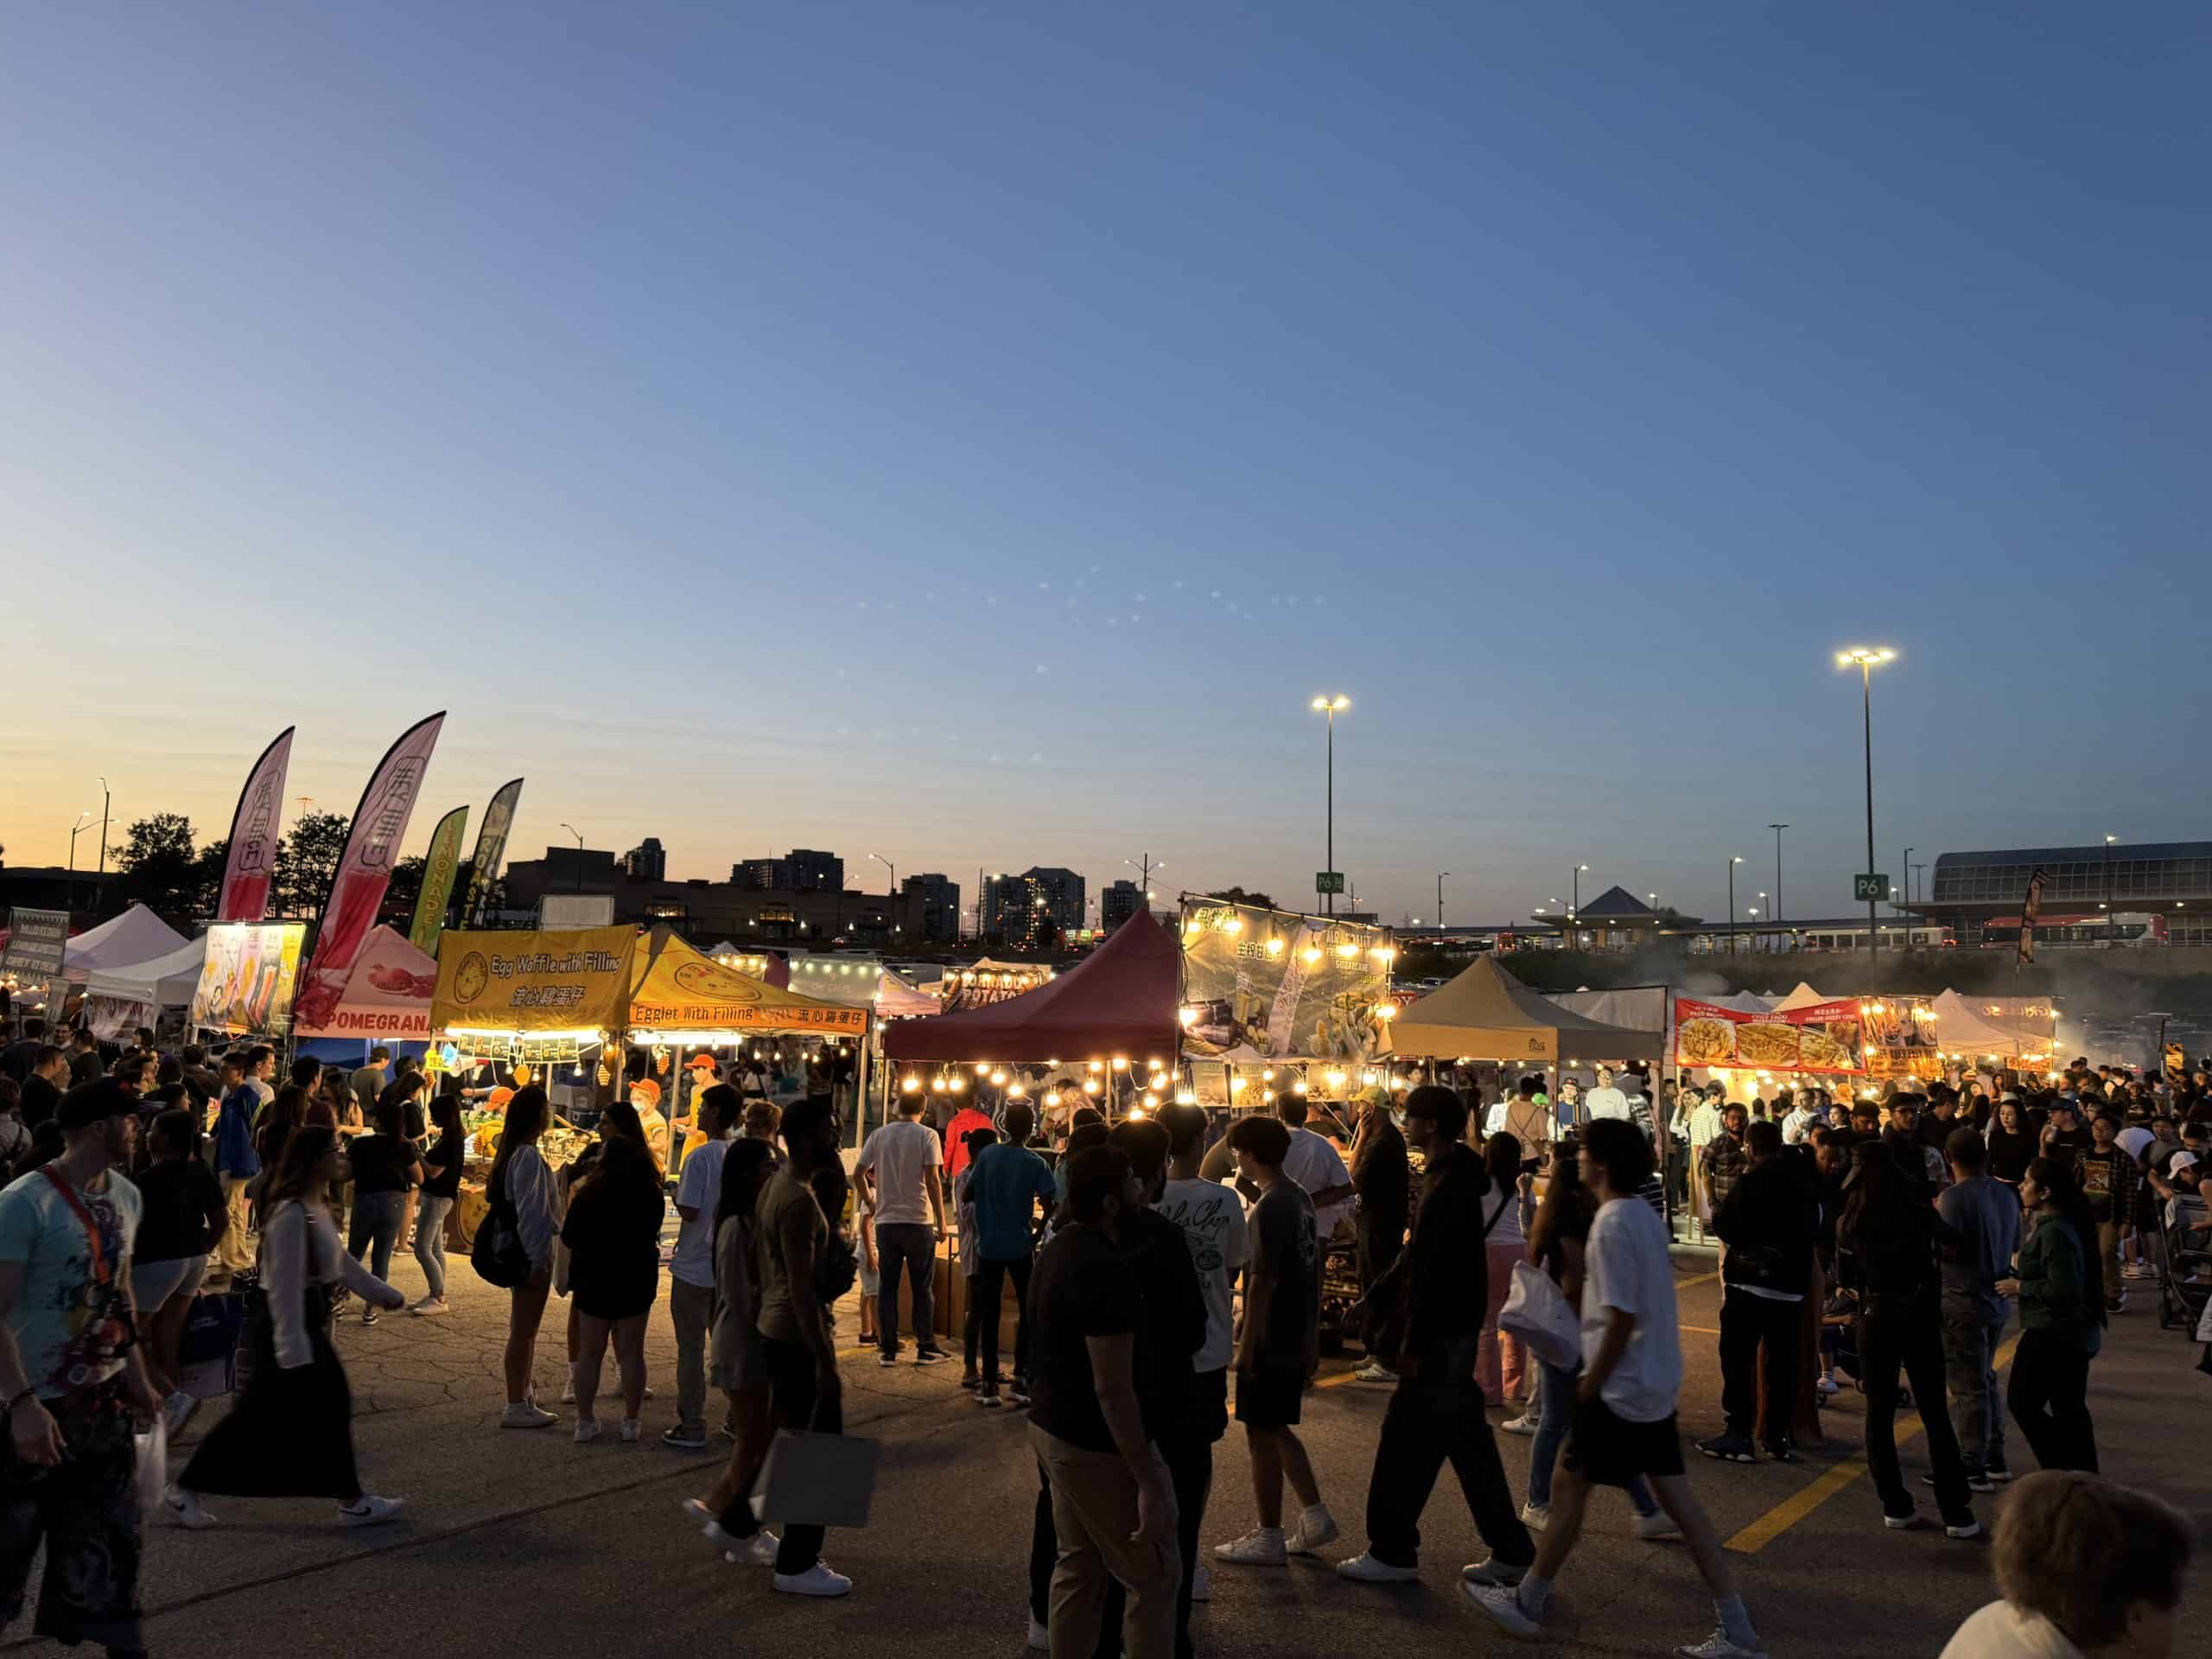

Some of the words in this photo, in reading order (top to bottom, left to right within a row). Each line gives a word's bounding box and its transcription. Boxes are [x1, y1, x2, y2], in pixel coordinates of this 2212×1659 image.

[1319, 876, 1332, 890] P6
[1859, 879, 1878, 896] P6
[490, 954, 513, 978] Egg
[516, 952, 557, 975] Waffle
[557, 952, 582, 975] with
[582, 950, 623, 975] Filling
[635, 1006, 678, 1025] Egglet
[683, 1005, 710, 1021] With
[713, 1006, 753, 1021] Filling
